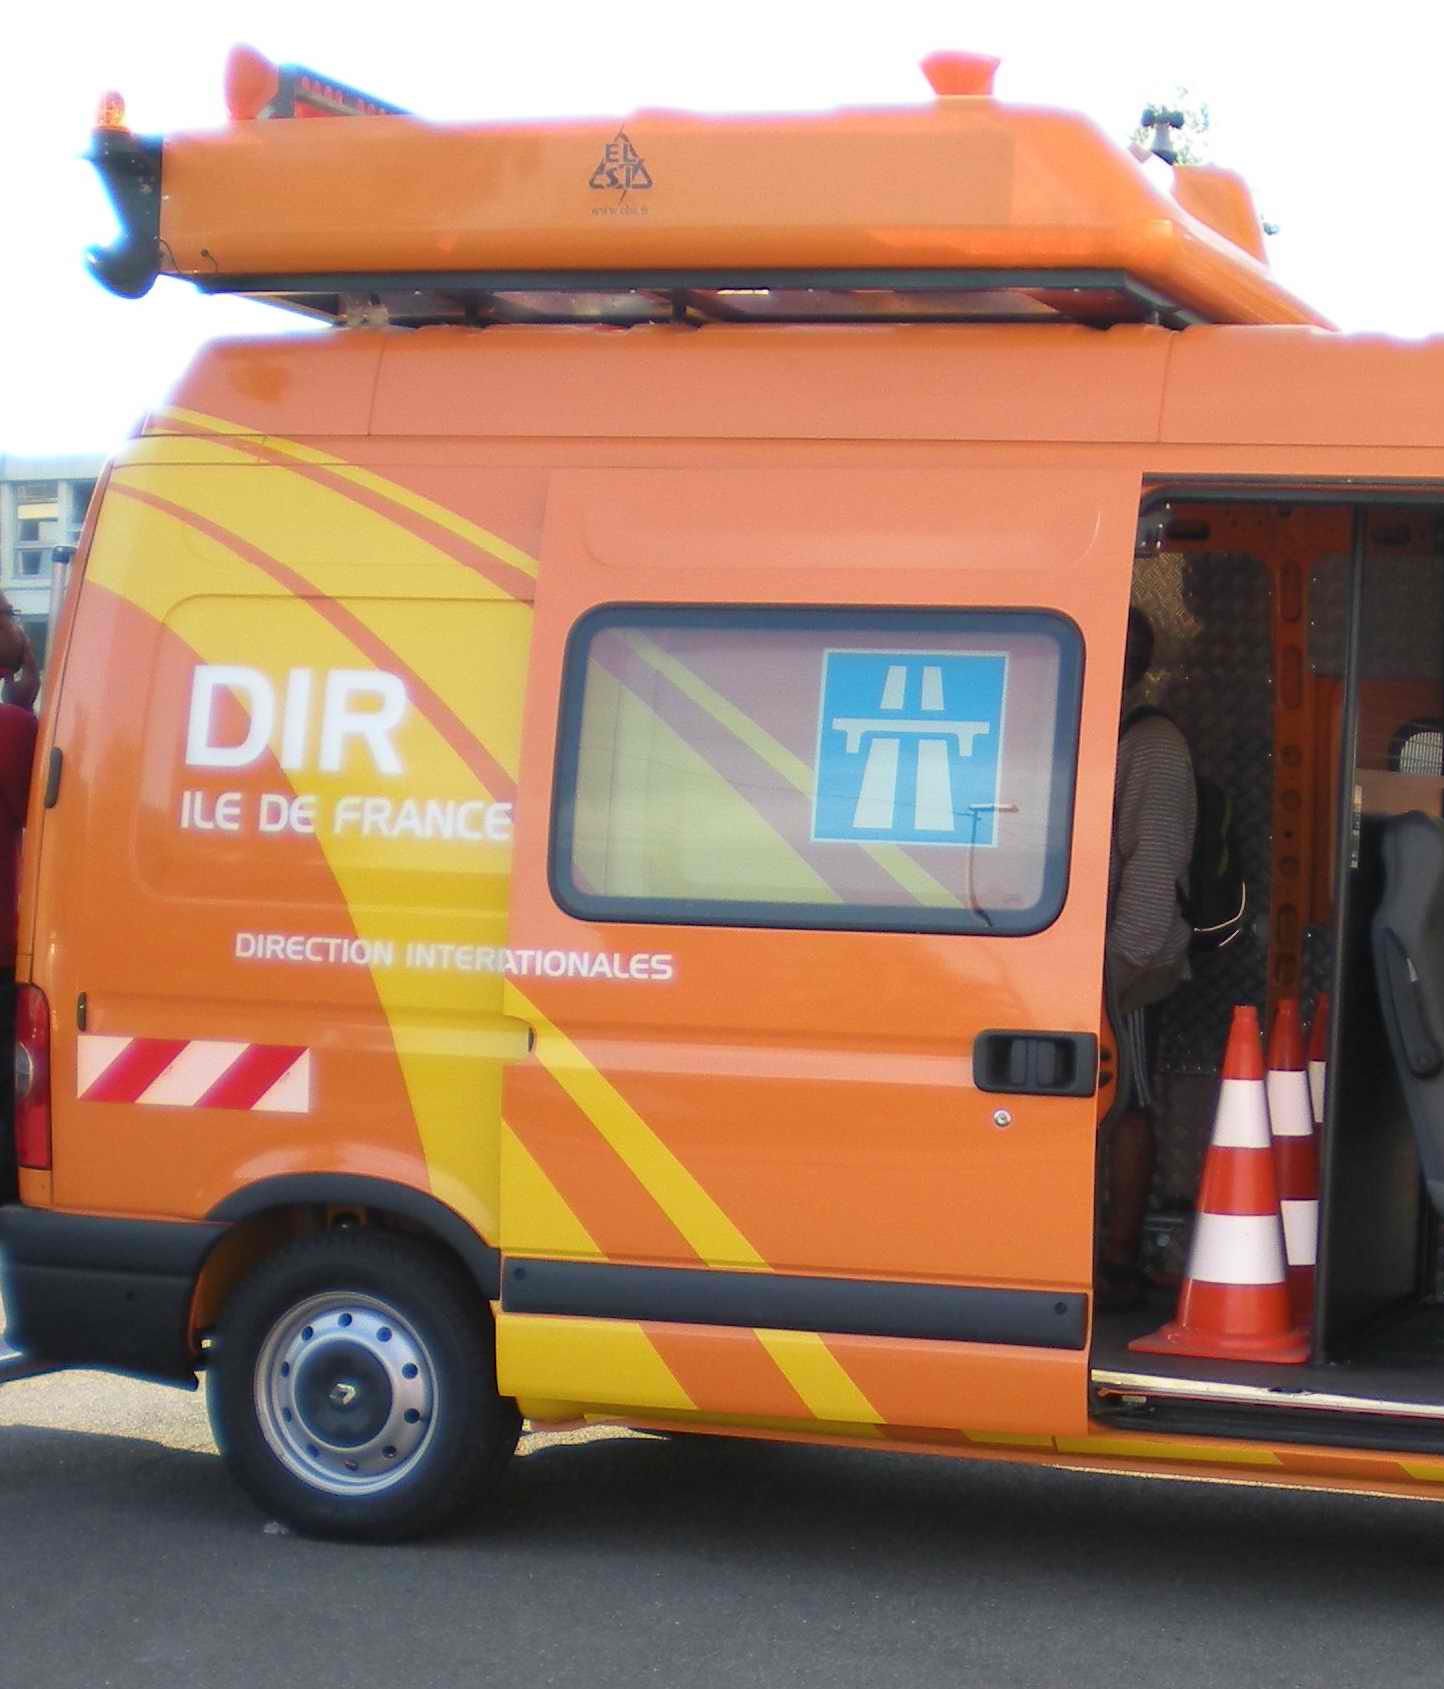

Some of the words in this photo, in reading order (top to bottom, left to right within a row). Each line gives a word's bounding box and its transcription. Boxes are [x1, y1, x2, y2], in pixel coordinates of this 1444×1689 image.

[185, 664, 409, 775] DIR
[180, 791, 243, 830] ILE
[259, 793, 316, 833] DE
[333, 796, 513, 842] FRANCE
[235, 932, 393, 966] DIRECTION
[405, 942, 674, 981] INTERATIONALES
